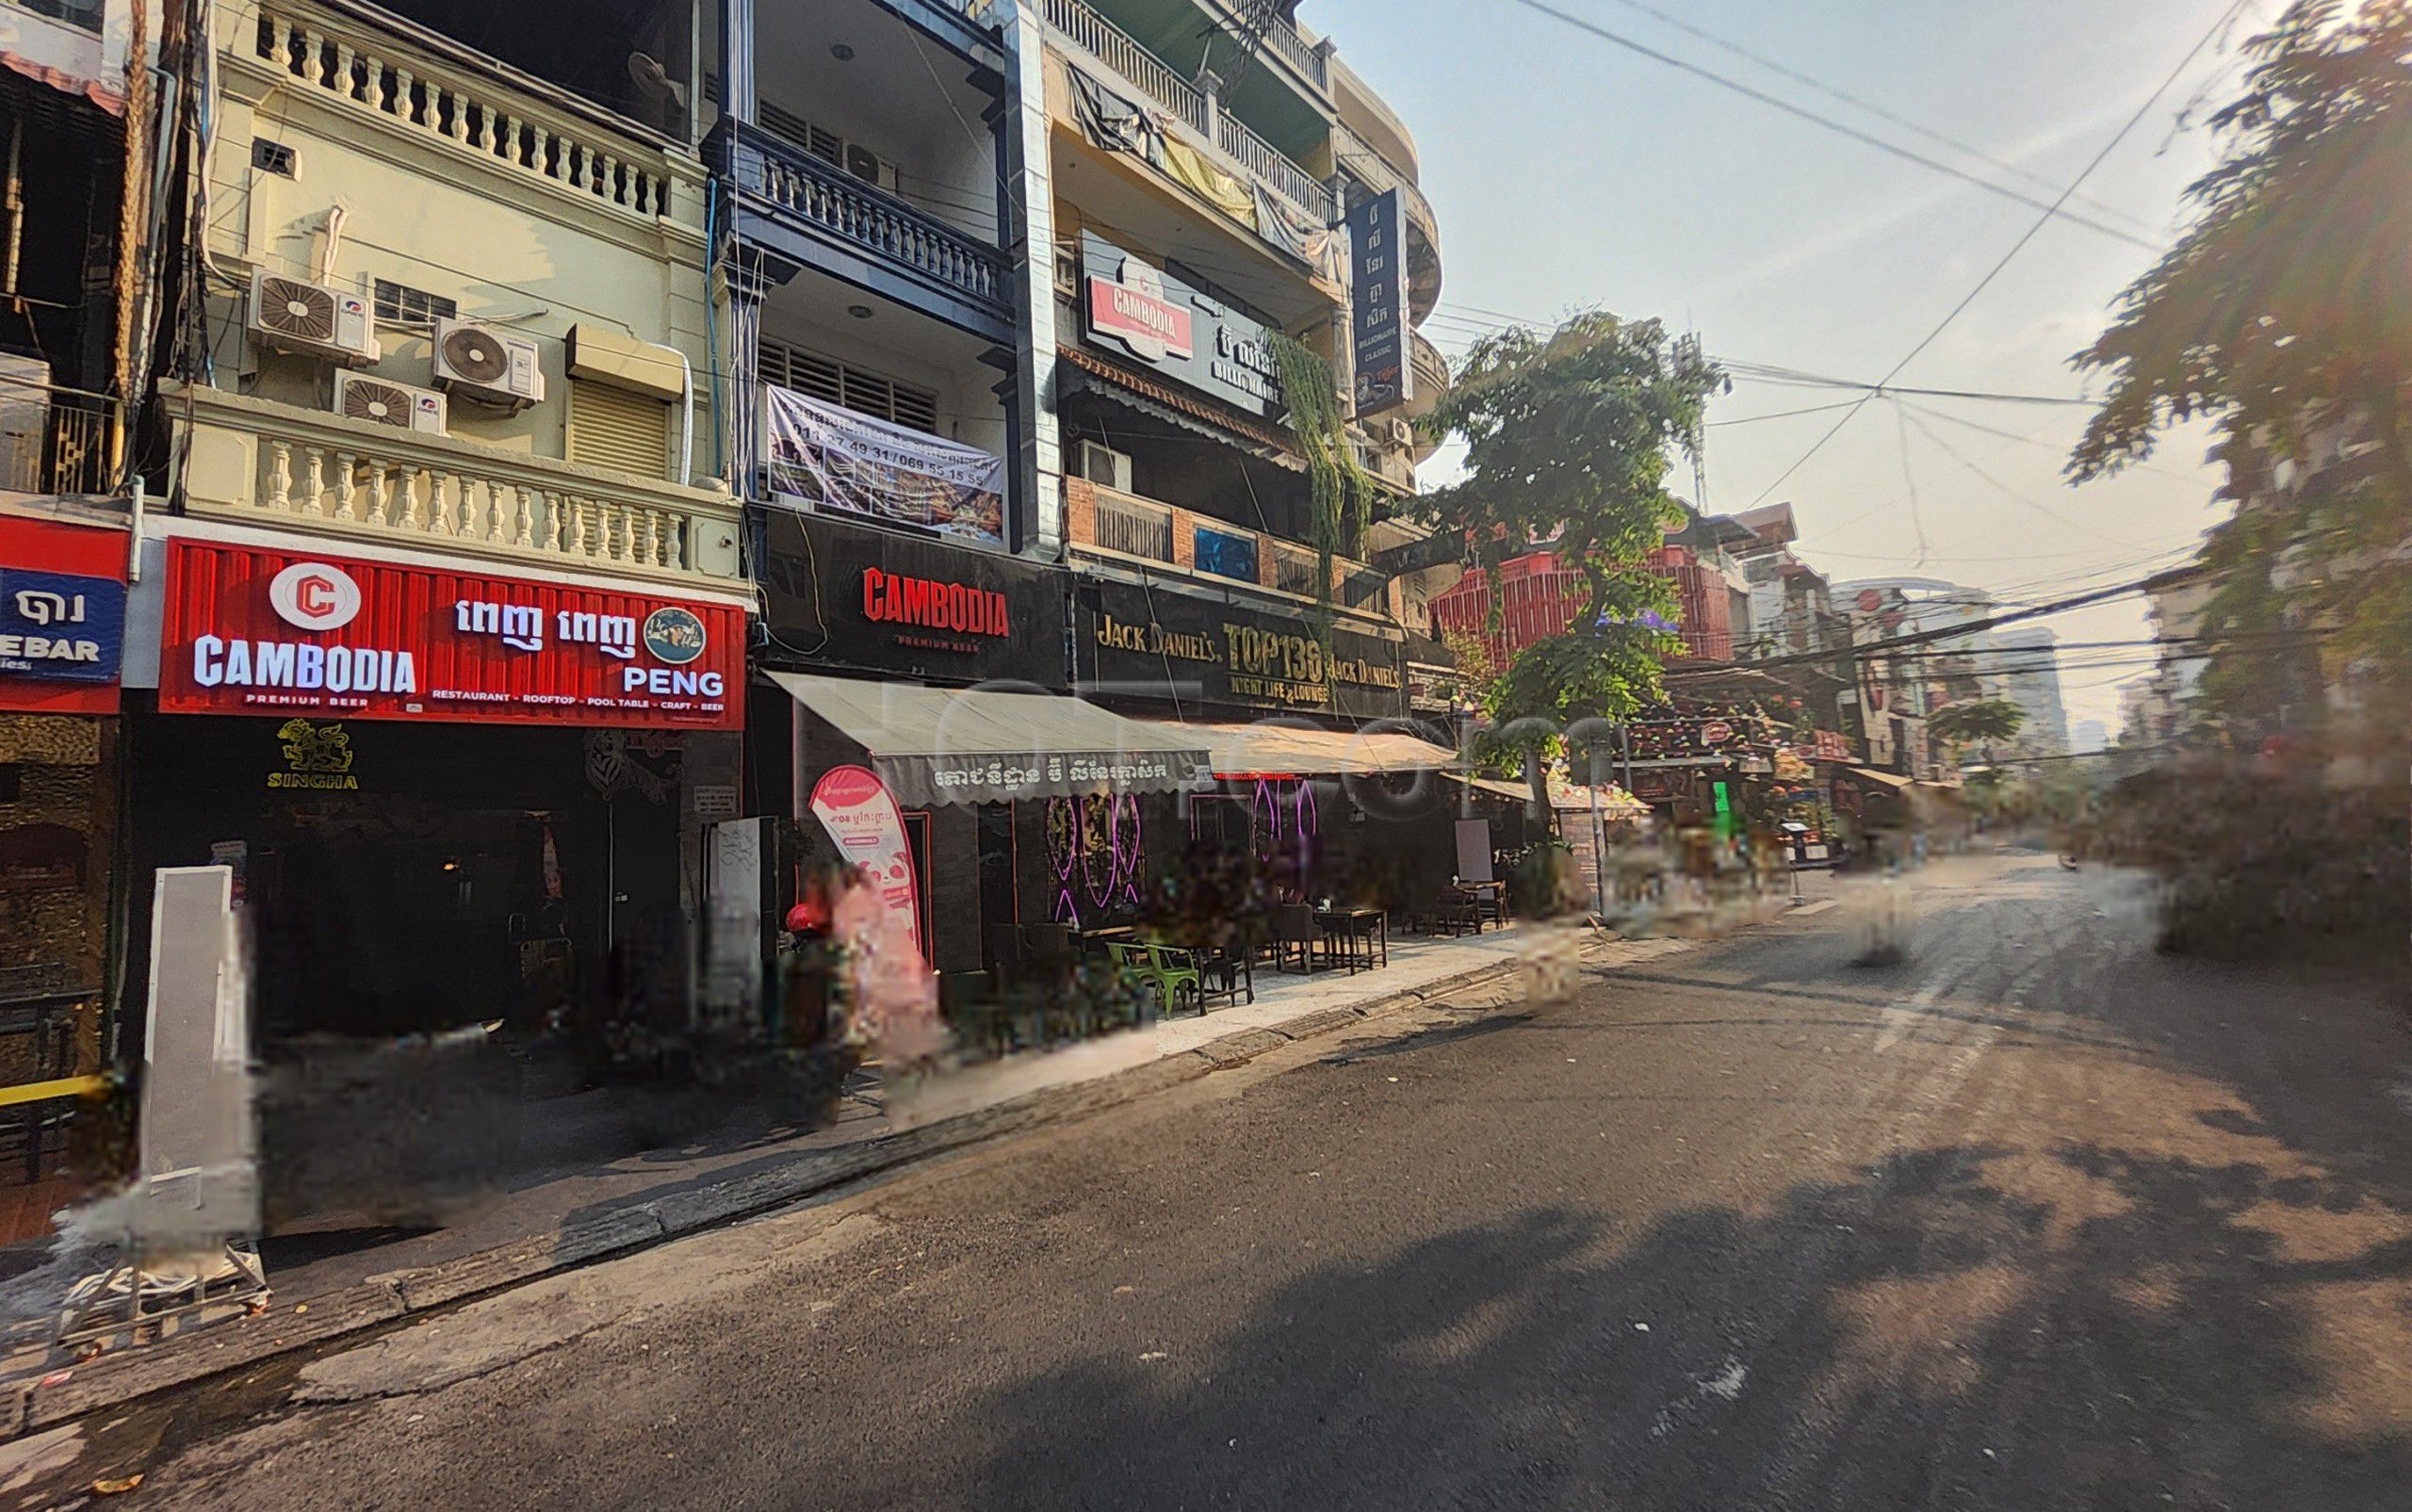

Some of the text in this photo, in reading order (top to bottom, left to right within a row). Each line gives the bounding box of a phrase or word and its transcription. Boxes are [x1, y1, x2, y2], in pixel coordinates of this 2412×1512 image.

[1114, 287, 1176, 339] CAMBODIA
[850, 441, 867, 455] 49
[929, 463, 945, 477] 55
[950, 468, 964, 481] 15
[968, 473, 984, 487] 55
[862, 567, 1009, 637] CAMBODIA
[898, 635, 950, 650] PREMIUM
[1098, 614, 1147, 652] JACK
[194, 633, 416, 693] CAMBODIA
[624, 667, 724, 697] PENG
[1230, 676, 1263, 696] NIGHT
[1264, 680, 1285, 699] LIFE
[246, 694, 367, 707] PREMIUM BEER
[432, 690, 511, 702] RESTAURANT
[523, 694, 576, 705] ROOFTOP
[587, 697, 614, 707] POOL
[617, 699, 649, 708] TABLE
[660, 701, 692, 710] CRAFT
[267, 772, 359, 789] SINGHA
